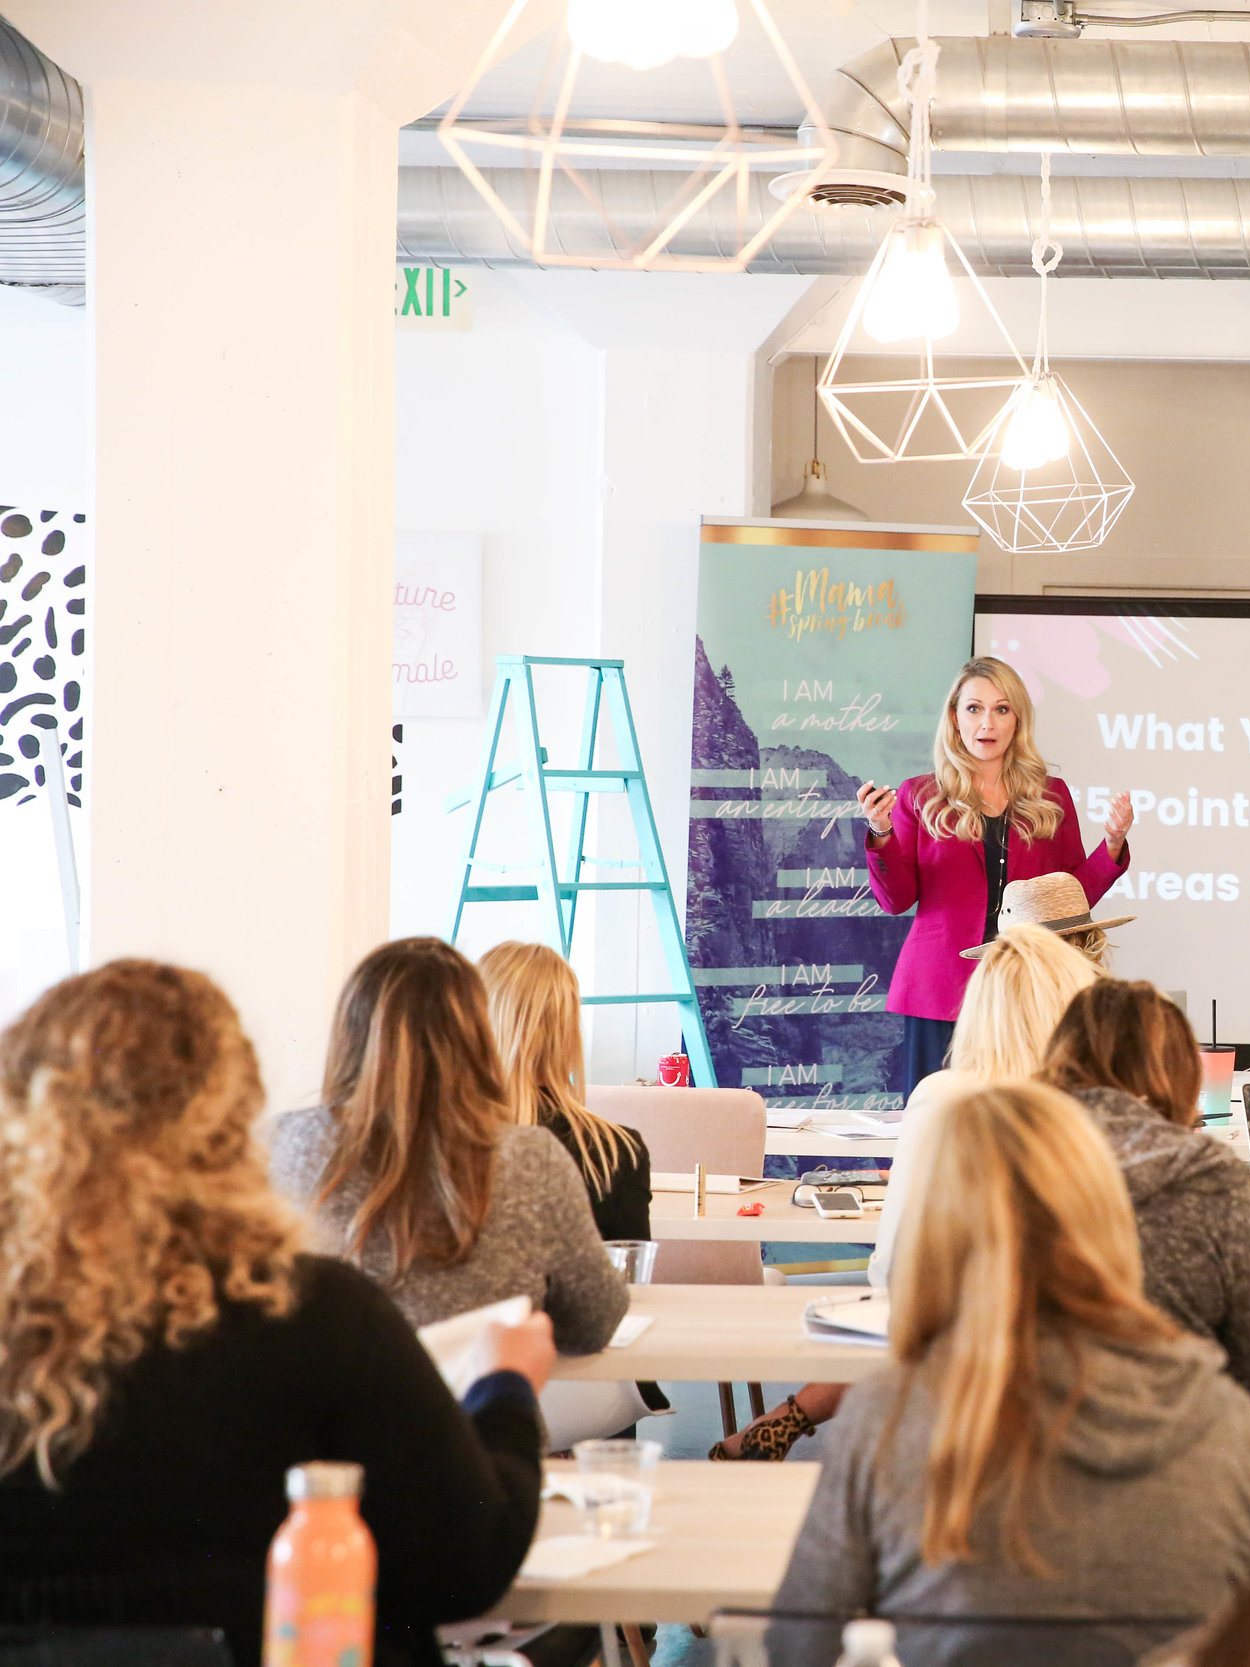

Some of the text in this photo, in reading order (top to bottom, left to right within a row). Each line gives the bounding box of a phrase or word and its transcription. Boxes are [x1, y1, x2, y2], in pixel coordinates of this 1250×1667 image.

[395, 268, 450, 316] XIT
[393, 582, 456, 611] ture
[392, 653, 459, 683] male
[783, 679, 833, 702] I AM
[771, 693, 900, 732] a mother
[1097, 713, 1225, 752] What
[750, 767, 800, 790] I AM
[715, 800, 759, 818] an
[806, 866, 855, 889] I AM
[1103, 870, 1240, 902] Areas
[765, 899, 791, 917] a
[780, 963, 831, 986] I AM
[731, 973, 882, 1030] free to be
[767, 1063, 818, 1087] I AM
